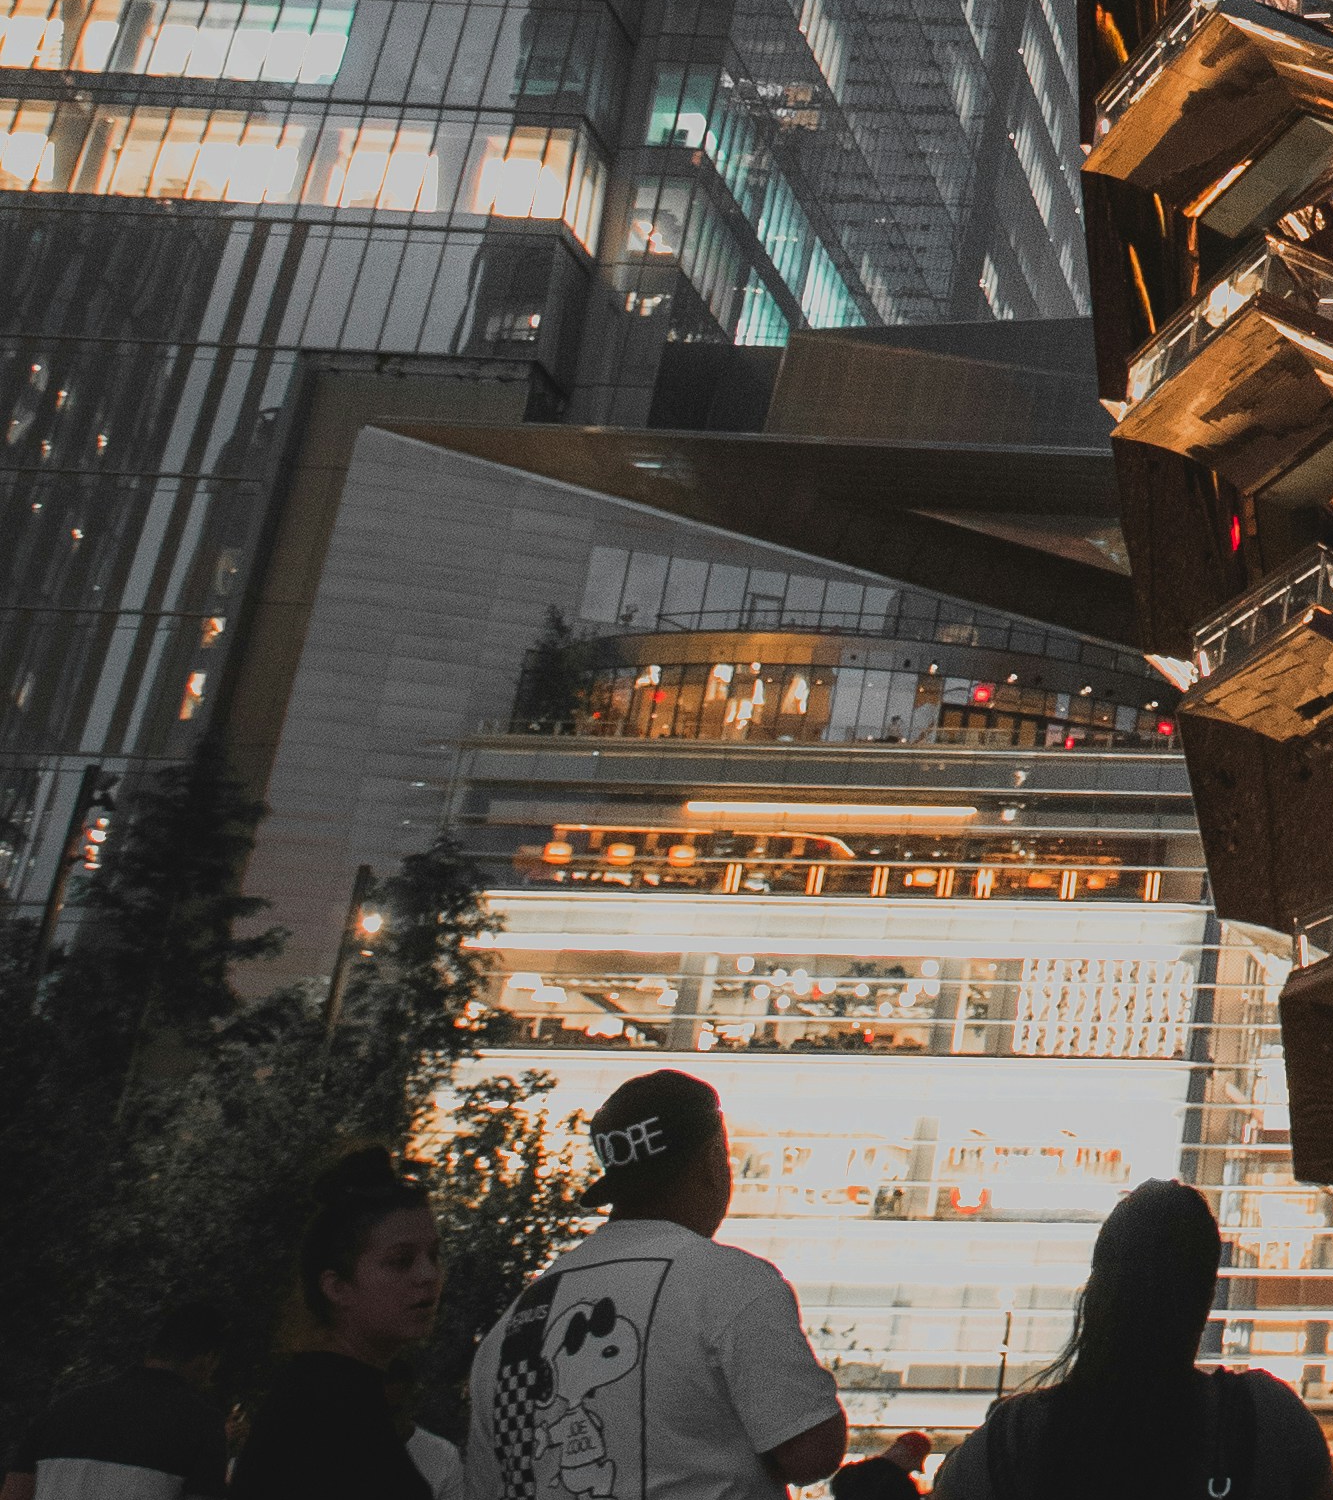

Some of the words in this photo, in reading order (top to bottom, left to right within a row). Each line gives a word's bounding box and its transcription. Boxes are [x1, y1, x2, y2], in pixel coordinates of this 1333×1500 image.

[596, 1116, 667, 1167] DOPE
[567, 1419, 589, 1438] JOE
[565, 1436, 598, 1455] COOL
